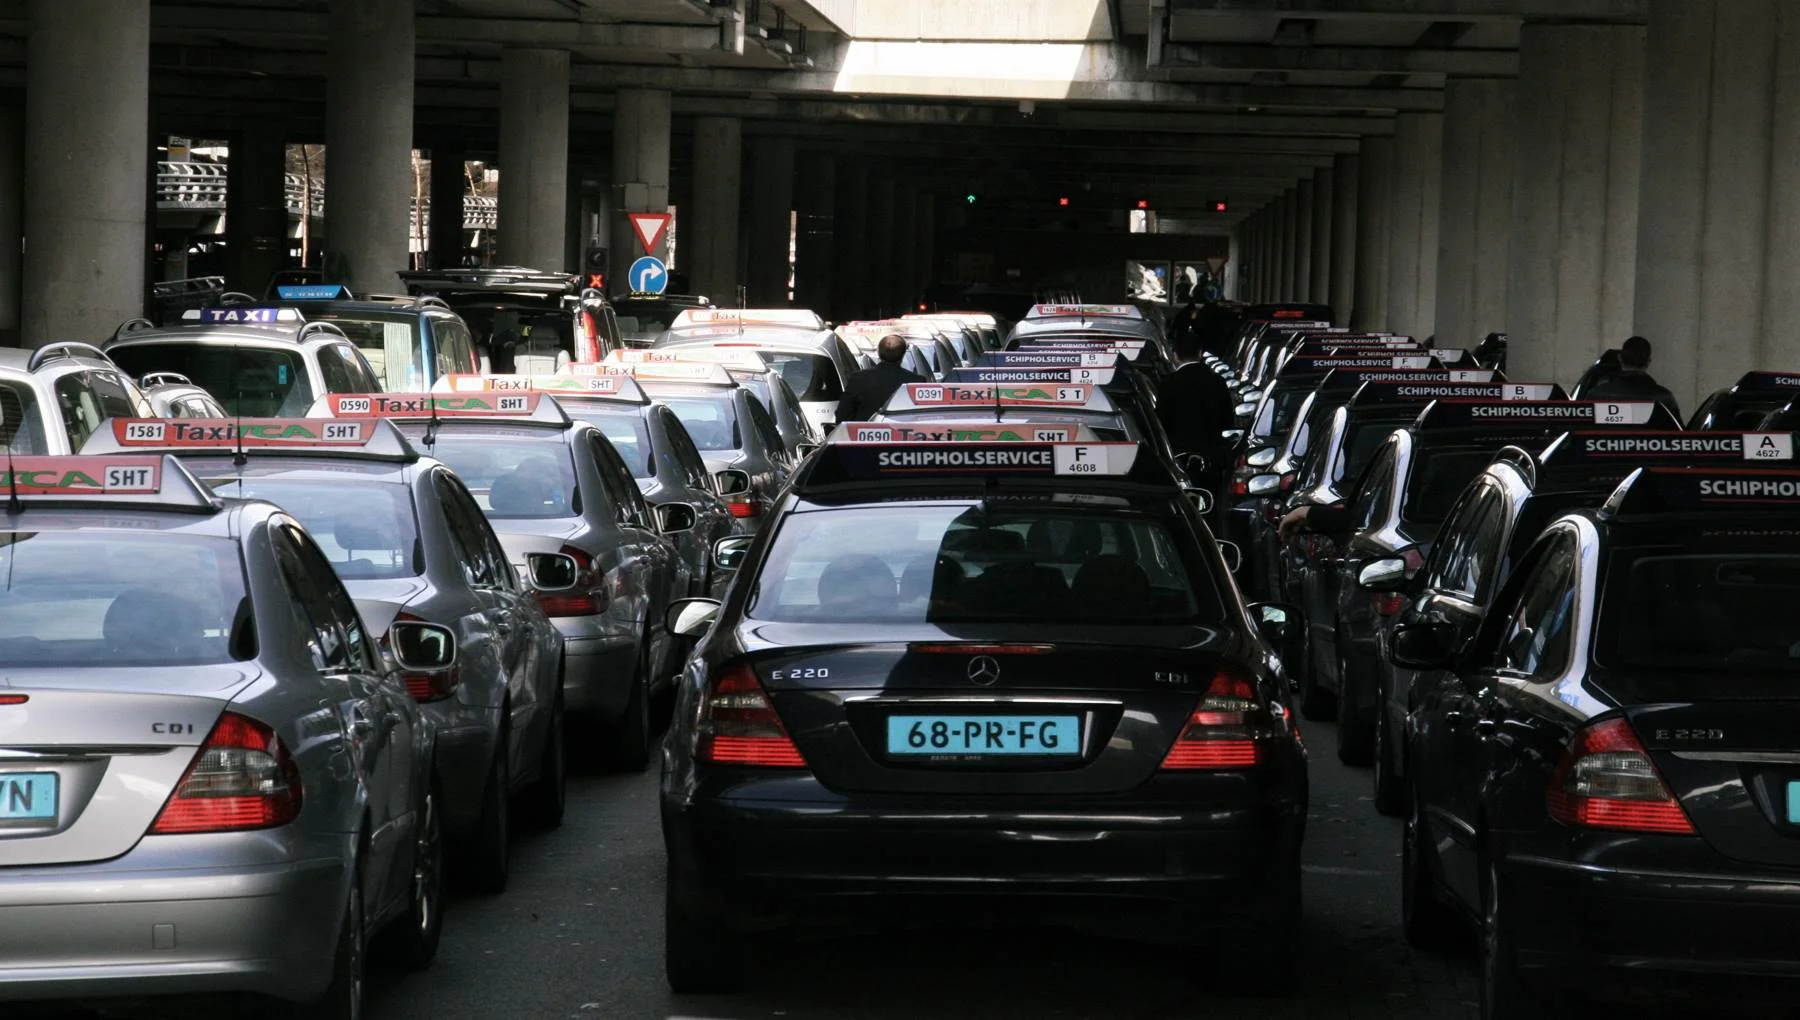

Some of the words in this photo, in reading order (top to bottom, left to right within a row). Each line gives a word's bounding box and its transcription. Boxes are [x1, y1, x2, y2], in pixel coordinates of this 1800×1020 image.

[211, 310, 271, 321] TAXI
[1005, 355, 1080, 363] SCHIPHOLSERVICE
[1313, 359, 1391, 367] SCHIPHOLSERVICE
[600, 366, 636, 376] Taxi
[979, 372, 1069, 381] SCHIPHOLSERVICE
[1082, 370, 1090, 378] D
[1359, 373, 1448, 382] SCHIPHOLSERVICE
[1460, 372, 1467, 380] F
[488, 379, 528, 391] Taxi
[591, 380, 612, 389] SHT
[917, 387, 942, 400] 0391
[950, 387, 992, 400] Taxi
[1397, 386, 1500, 397] SCHIPHOLSERVICE
[1515, 386, 1524, 395] B
[340, 399, 369, 411] 0590
[376, 397, 425, 412] Taxi
[500, 398, 523, 409] SHT
[1472, 406, 1592, 417] SCHIPHOLSERVICE
[1608, 405, 1619, 416] D
[128, 424, 163, 438] 1581
[172, 423, 233, 440] Taxi
[327, 425, 357, 438] SHT
[859, 430, 890, 441] 0690
[898, 429, 951, 441] Taxi
[1037, 431, 1064, 441] SHT
[1586, 439, 1741, 451] SCHIPHOLSERVICE
[1760, 436, 1775, 448] A
[879, 451, 1051, 466] SCHIPHOLSERVICE
[1075, 447, 1088, 462] F
[1755, 450, 1780, 458] 4627
[1069, 463, 1097, 473] 4608
[110, 469, 149, 487] SHT
[772, 671, 782, 680] E
[791, 668, 829, 679] 220
[152, 722, 193, 735] CDI
[907, 720, 1059, 749] 68-PR-FG
[1656, 728, 1669, 740] E
[0, 779, 32, 812] N
